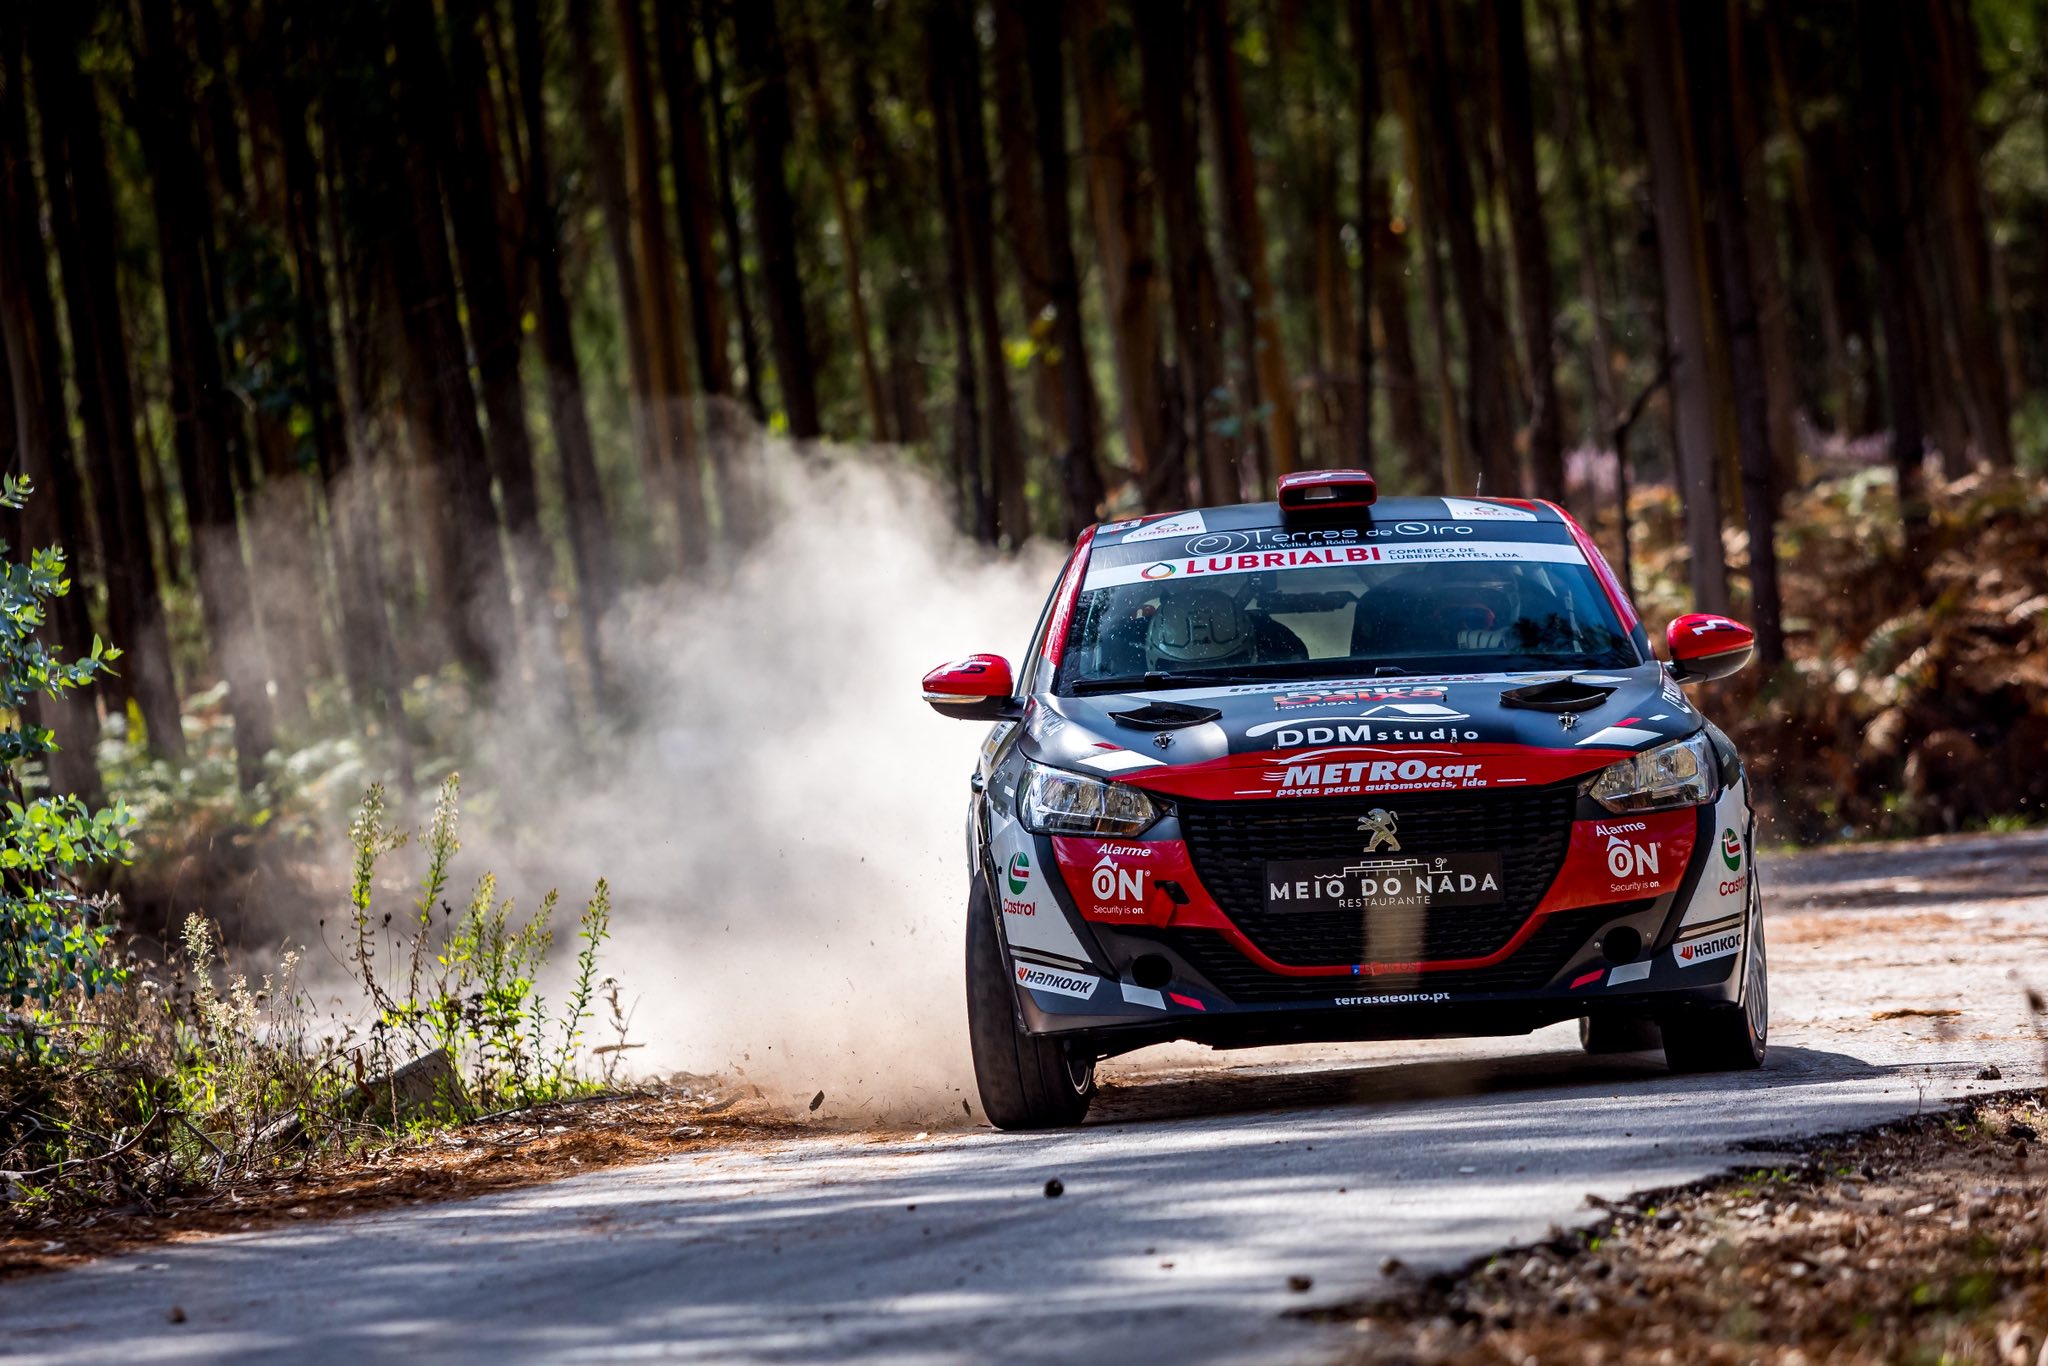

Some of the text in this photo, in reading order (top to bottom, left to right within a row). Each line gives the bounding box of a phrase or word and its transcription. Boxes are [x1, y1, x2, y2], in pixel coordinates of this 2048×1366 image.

[1243, 522, 1473, 544] Terras de Oiro
[1186, 547, 1381, 575] LUBRIALBI
[1283, 760, 1481, 787] METROcar
[1276, 778, 1487, 798] peças para automoveis, lda
[1595, 821, 1647, 837] Alarme
[1097, 843, 1152, 857] Alarme
[1269, 873, 1497, 900] MEIO DO NADA
[1610, 882, 1641, 892] Security
[1643, 880, 1649, 888] is
[1003, 898, 1036, 916] Castrol
[1093, 905, 1145, 916] Security is on.
[1338, 896, 1431, 908] RESTAURANTE
[1334, 993, 1450, 1006] terrasdeoiro.pt
